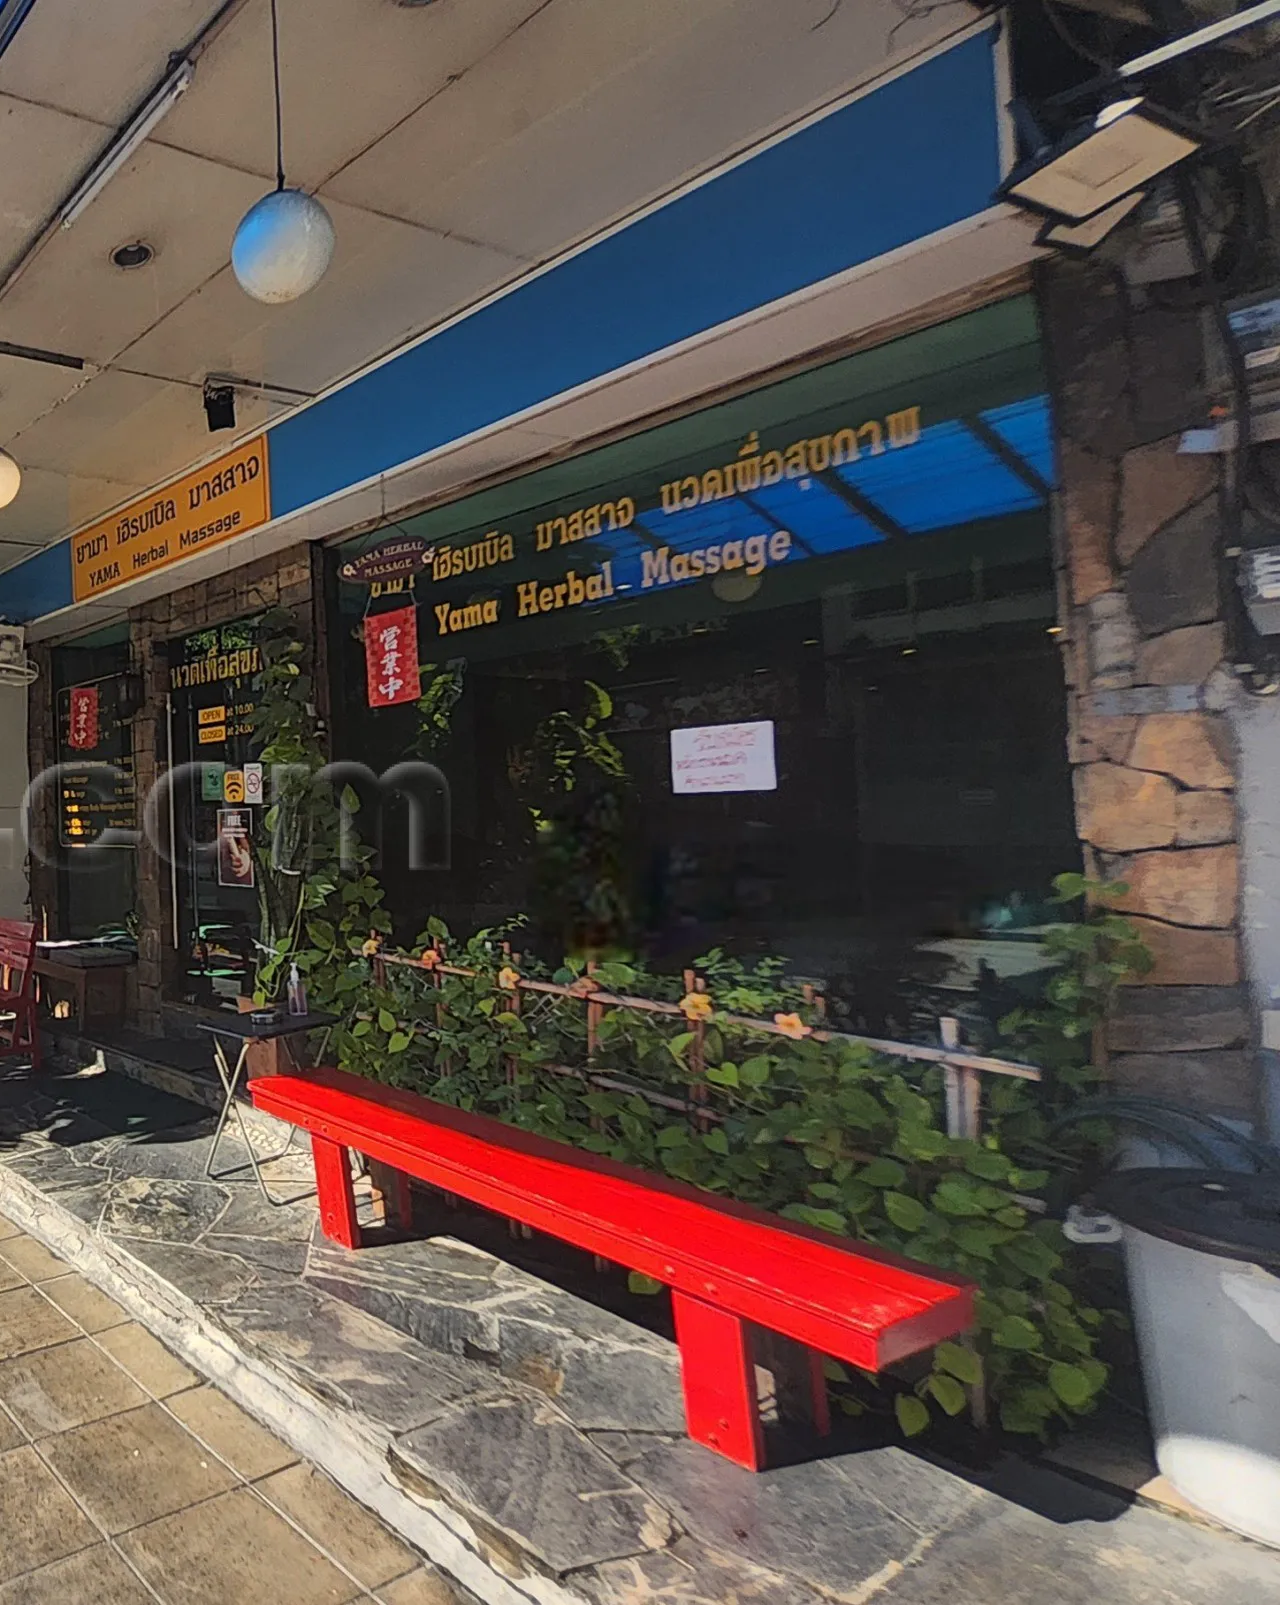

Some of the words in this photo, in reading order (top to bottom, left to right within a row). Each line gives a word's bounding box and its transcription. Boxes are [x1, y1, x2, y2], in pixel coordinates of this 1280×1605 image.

[76, 534, 108, 564] ยามา
[89, 562, 120, 587] YAMA
[132, 540, 169, 569] Herbal
[179, 511, 241, 549] Massage
[354, 550, 381, 568] YAMA
[383, 541, 425, 556] HERBAL
[364, 558, 414, 577] MASSAGE
[434, 600, 498, 635] Yama
[517, 561, 615, 617] Herbal
[640, 530, 793, 588] Massage
[201, 710, 221, 722] OPEN
[200, 729, 224, 740] CLOSED
